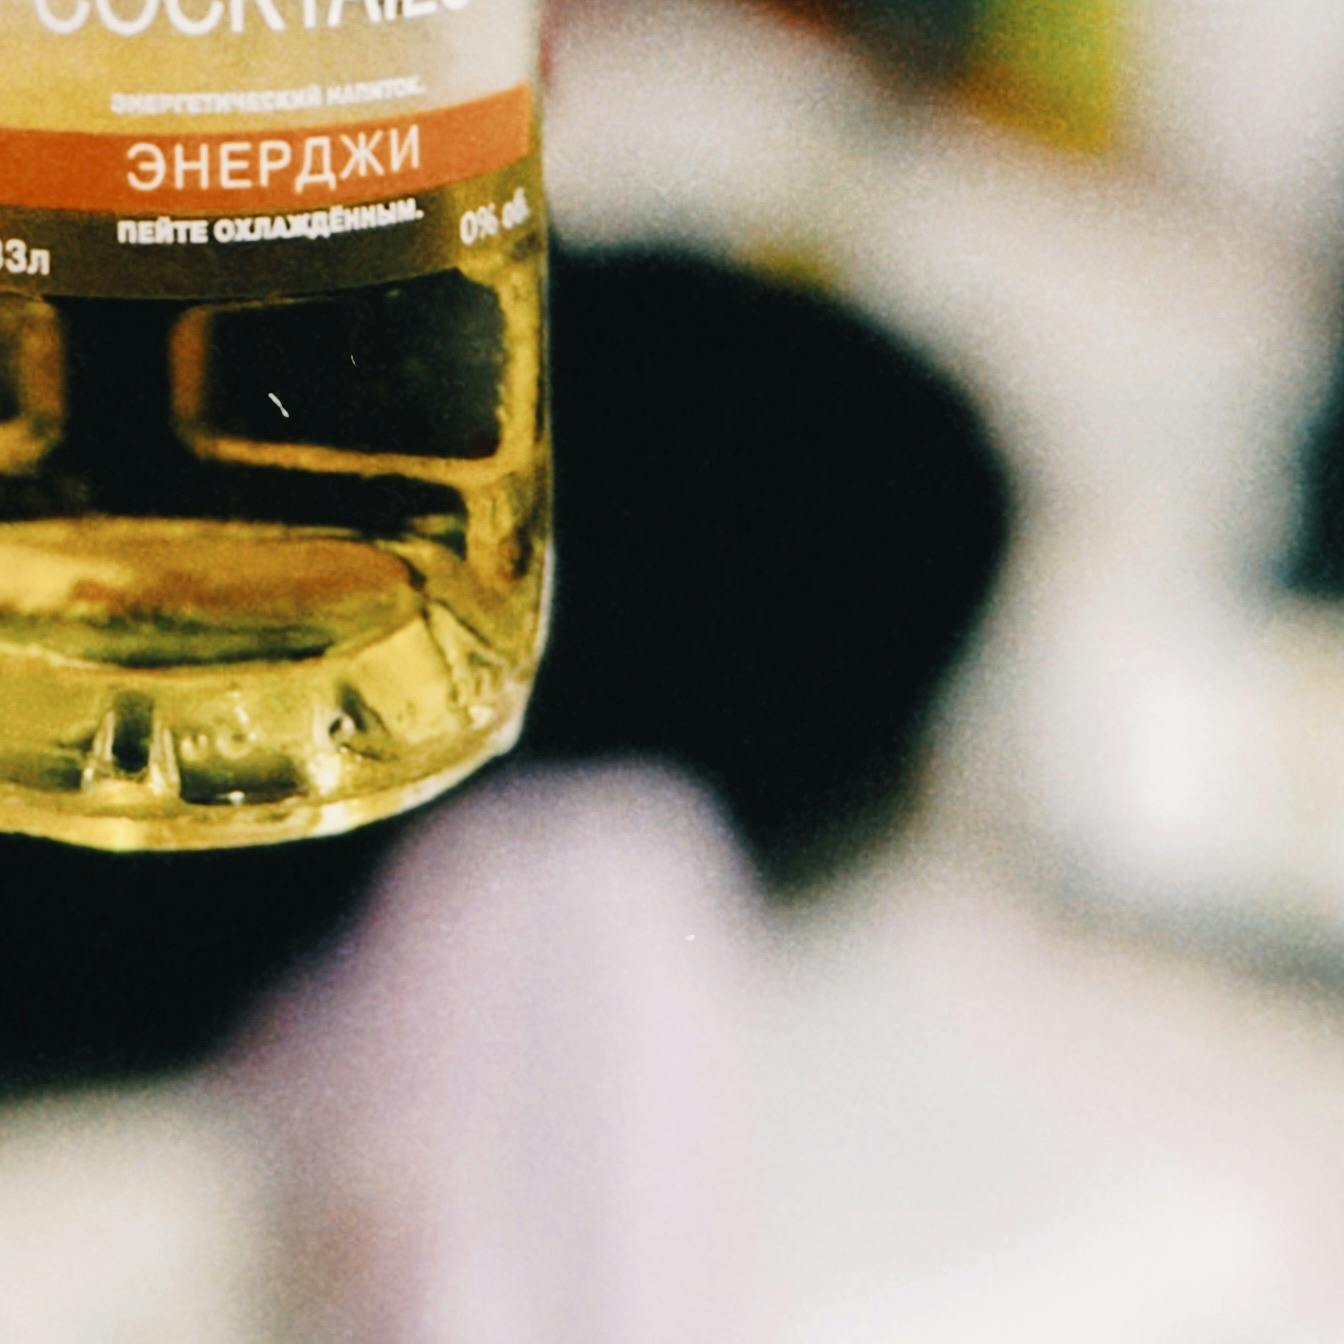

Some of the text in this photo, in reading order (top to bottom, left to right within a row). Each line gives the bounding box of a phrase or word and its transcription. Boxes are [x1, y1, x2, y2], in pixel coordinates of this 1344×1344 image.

[126, 124, 420, 194] ЭНЕРДЖИ
[116, 197, 425, 245] ПЕЙТЕ ОХЛАЖДЁННЫМ.
